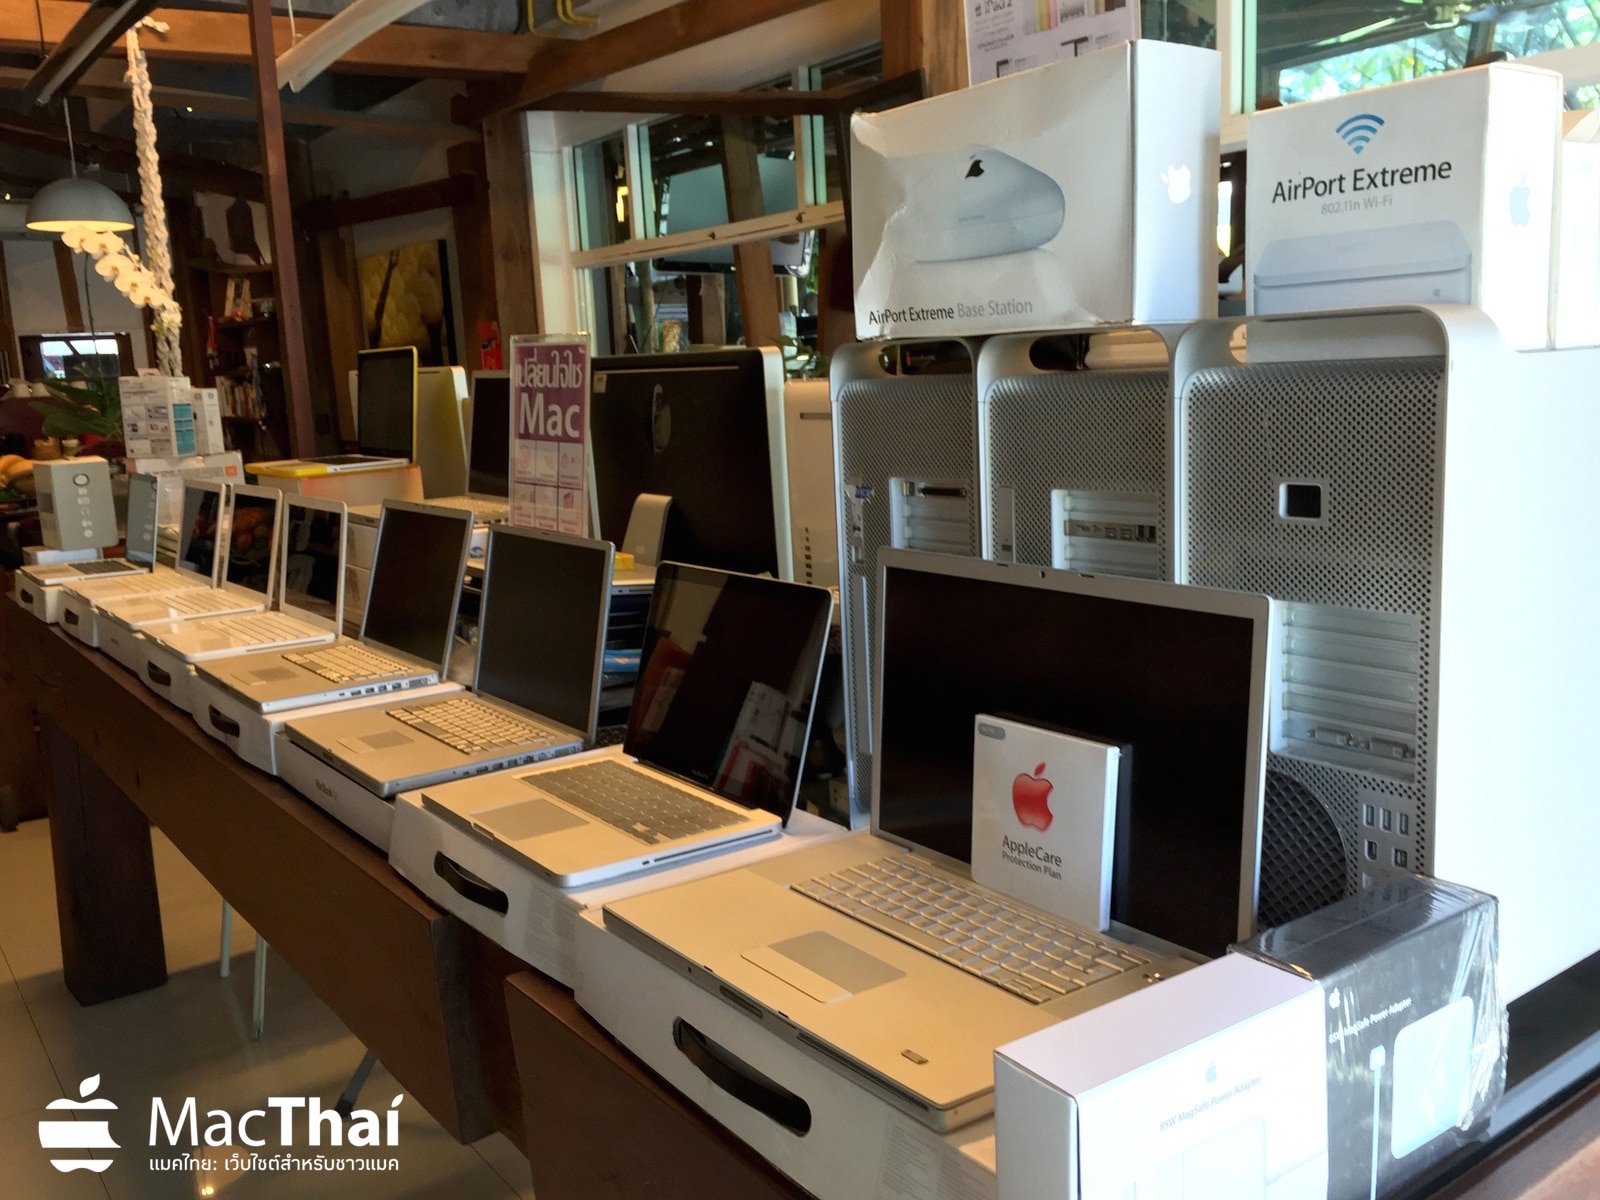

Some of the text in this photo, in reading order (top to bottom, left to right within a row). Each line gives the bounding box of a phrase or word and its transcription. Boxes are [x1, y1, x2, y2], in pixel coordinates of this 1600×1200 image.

[1272, 160, 1452, 203] AirPort Extreme
[1320, 194, 1394, 216] 802.11n Wi-Fi
[868, 299, 1034, 326] AirPort Extreme Base Station
[519, 391, 581, 439] Mac
[1001, 849, 1062, 881] Protection Plan
[1002, 835, 1062, 867] AppleCare
[1159, 1076, 1262, 1132] 85W MagSafe Power Adapter
